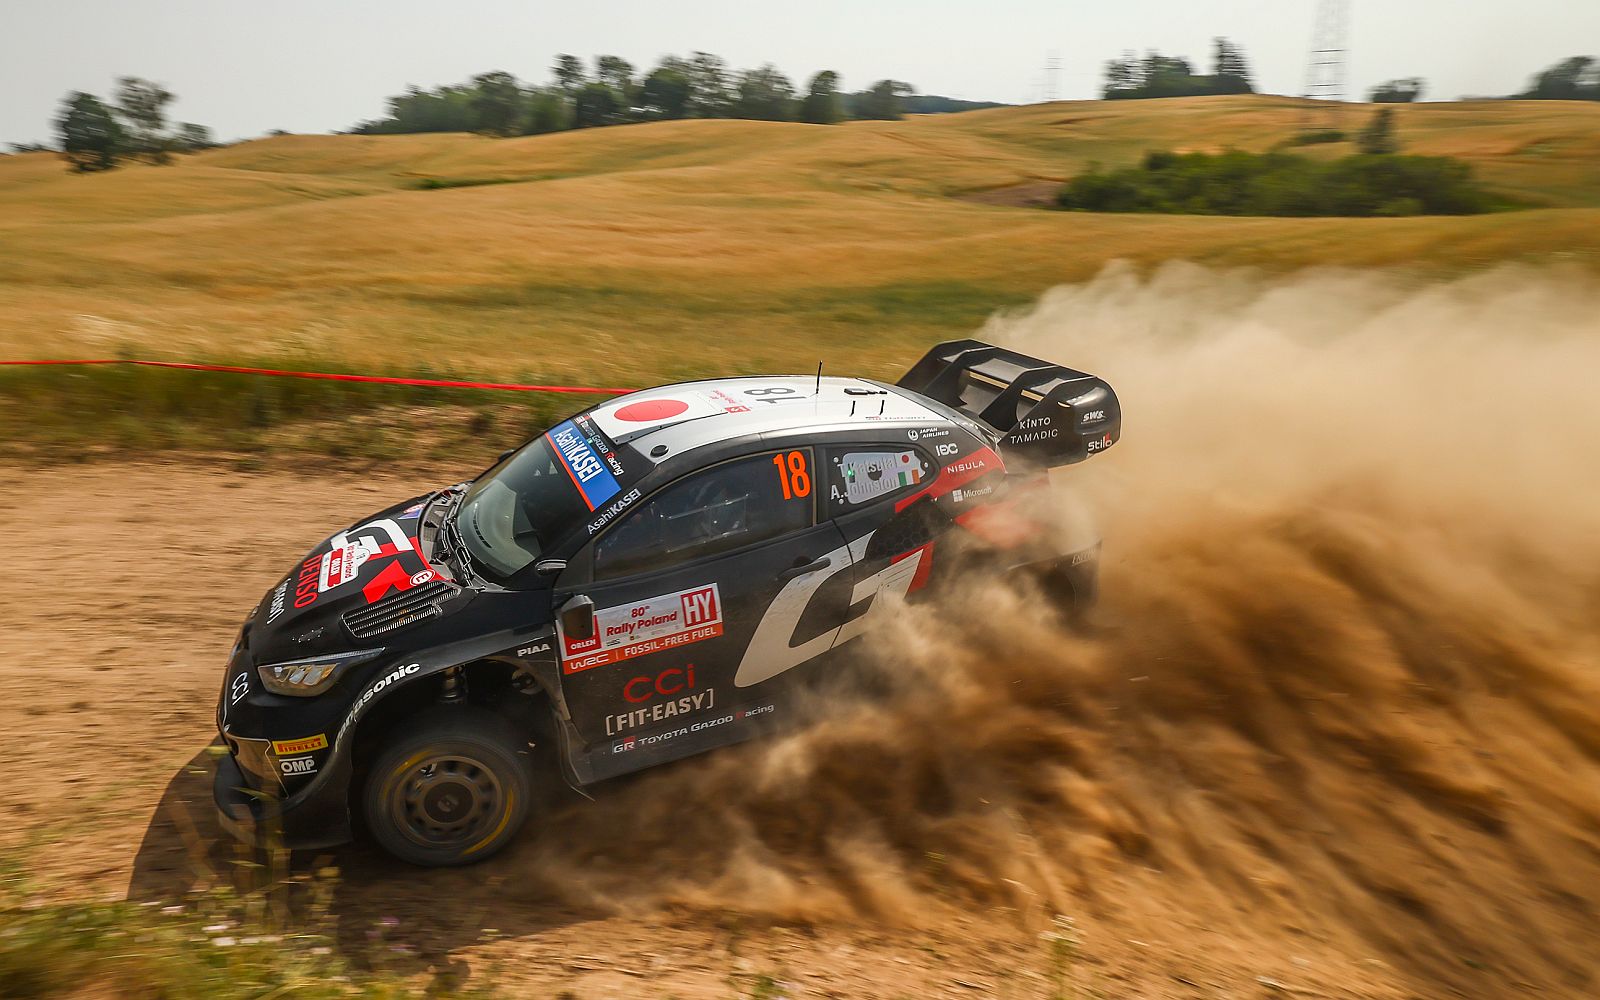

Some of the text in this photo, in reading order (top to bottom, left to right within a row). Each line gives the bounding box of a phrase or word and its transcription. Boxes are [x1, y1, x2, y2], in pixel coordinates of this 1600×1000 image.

[922, 430, 950, 439] AIRLINES
[1010, 428, 1058, 445] TAMADIC
[1087, 432, 1113, 452] Stilo
[553, 426, 604, 484] AsahiKASEI
[947, 460, 985, 474] NISULA
[772, 451, 811, 500] 18
[587, 488, 642, 535] AsahiKASEI
[294, 553, 323, 609] DENSO
[683, 591, 712, 626] HY
[606, 622, 636, 636] Rally
[637, 611, 677, 629] Poland
[517, 643, 551, 657] PIAA
[570, 639, 597, 650] ORLEN
[624, 636, 690, 657] FOSSIL-FREE
[691, 626, 718, 644] FUEL
[612, 737, 636, 754] GR
[638, 727, 688, 746] TOYOTA
[690, 714, 734, 732] GAZOO
[280, 758, 316, 774] OMP
